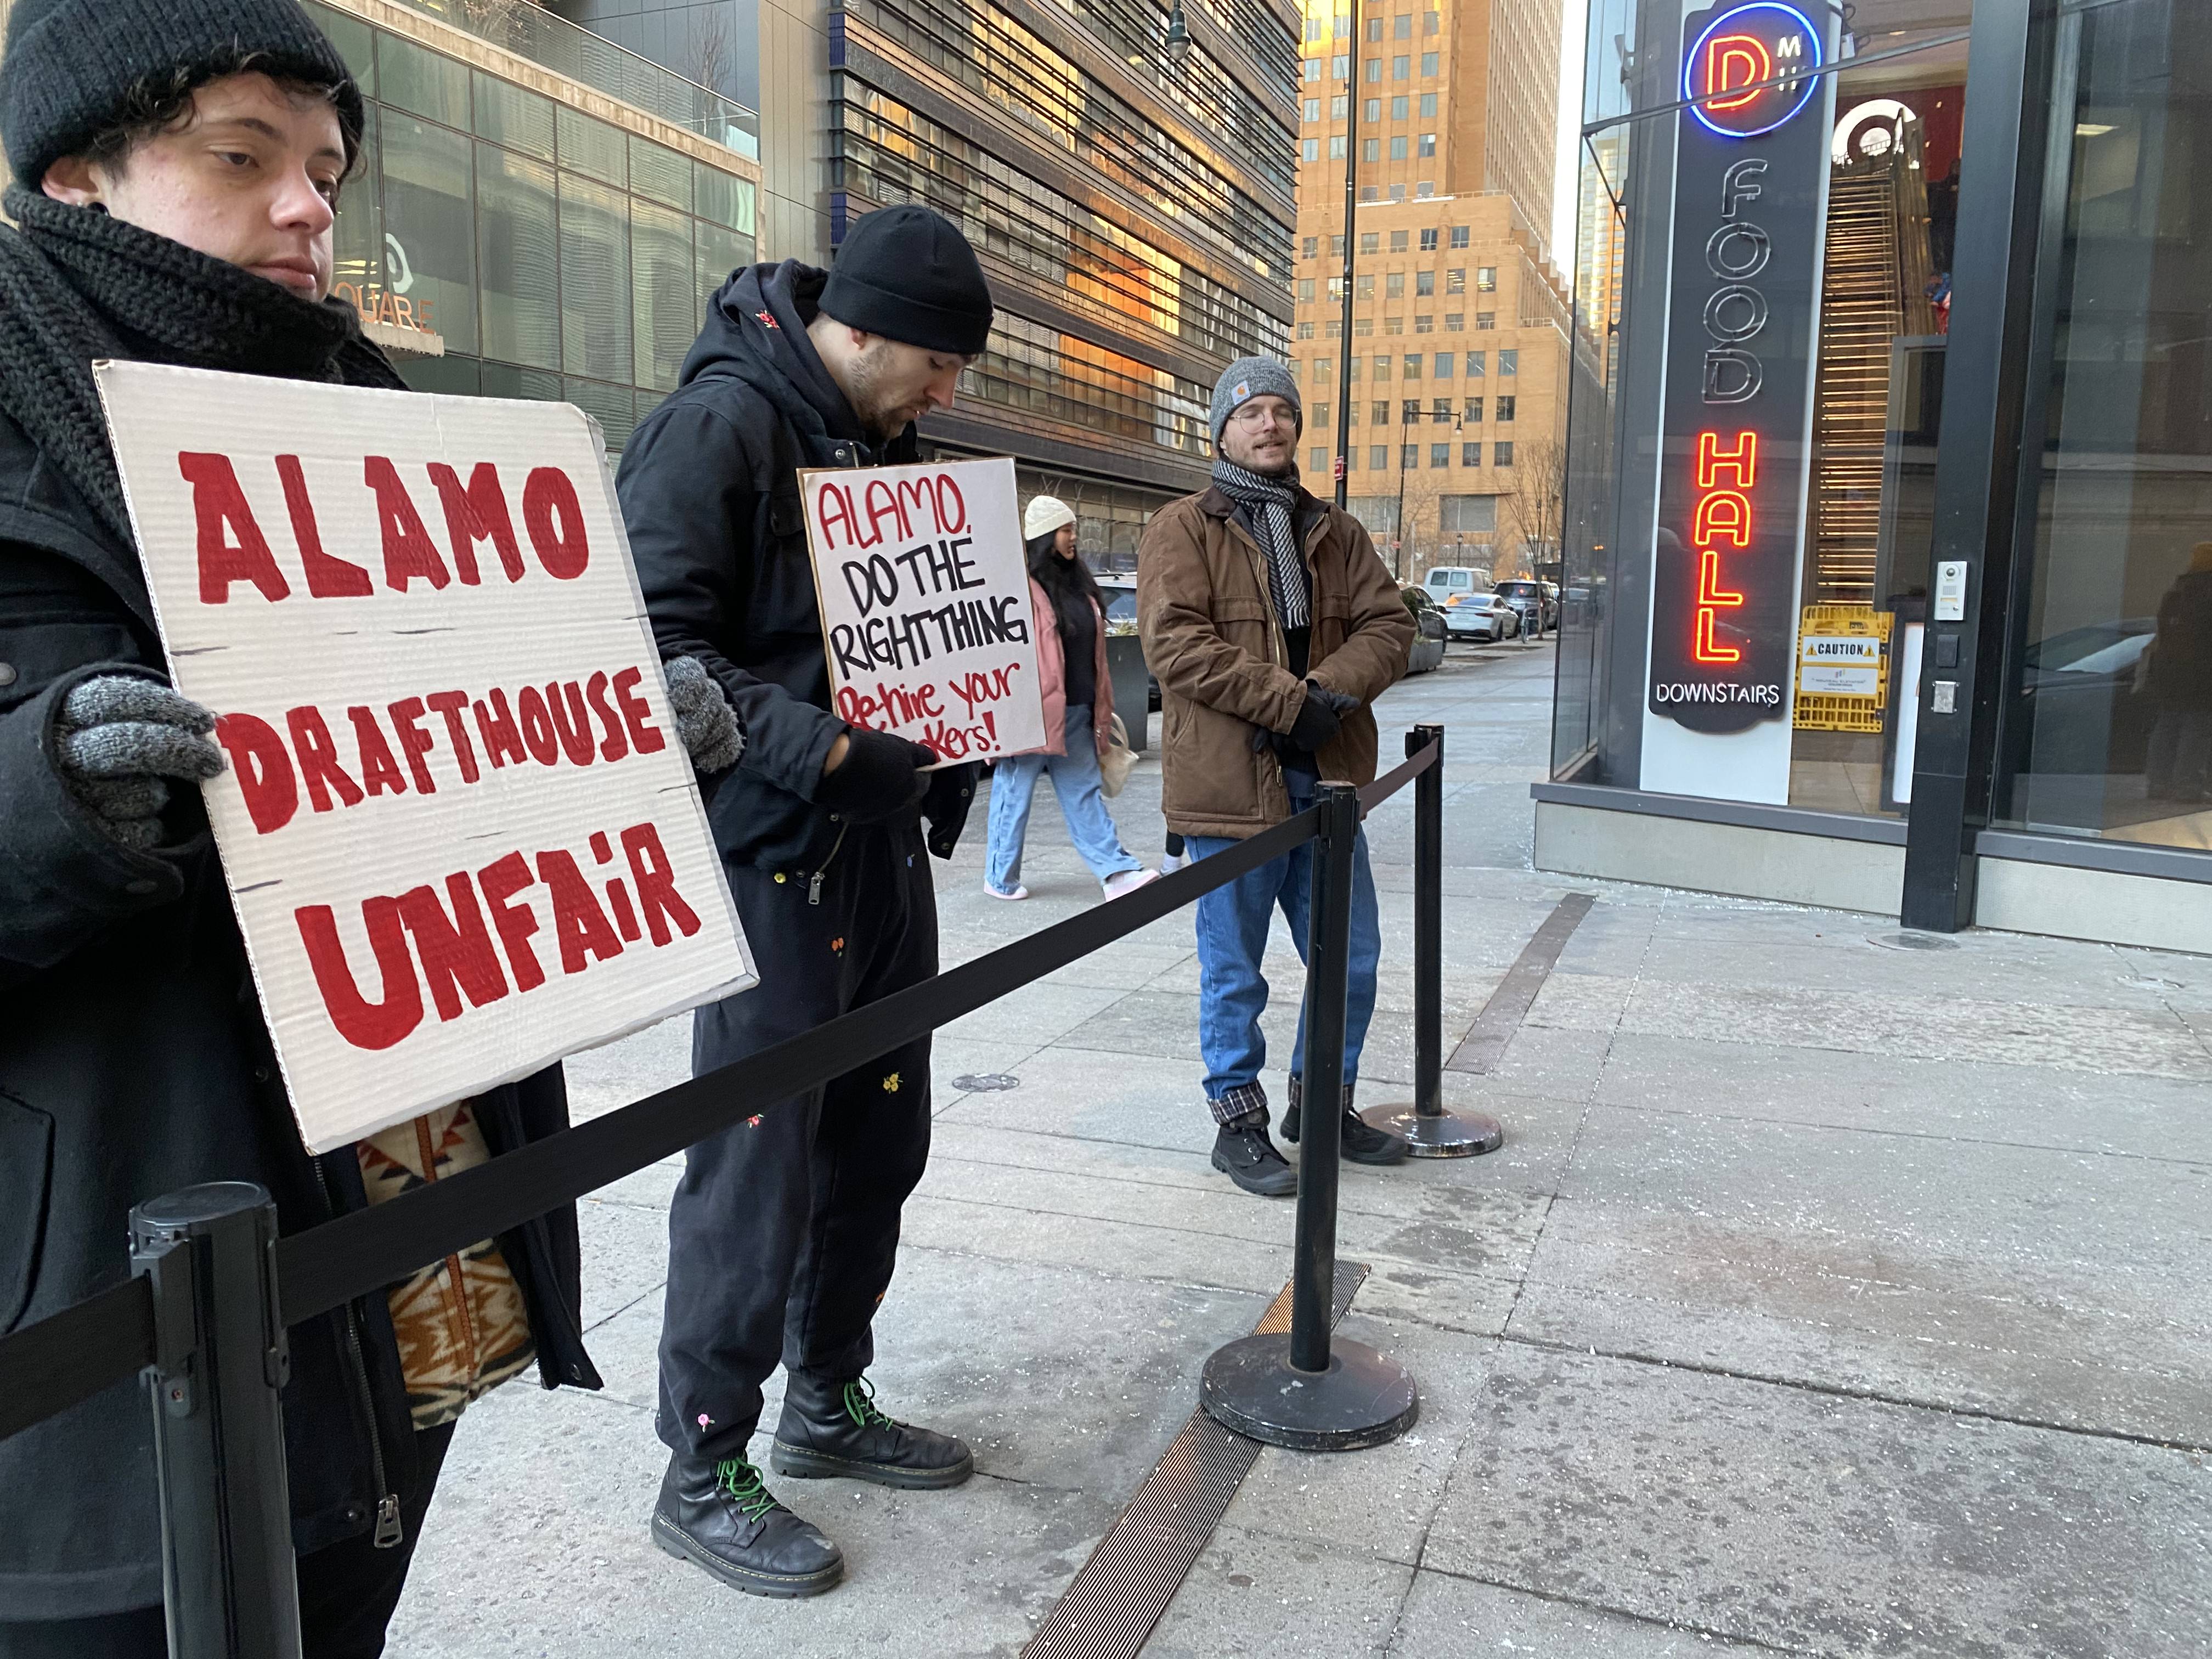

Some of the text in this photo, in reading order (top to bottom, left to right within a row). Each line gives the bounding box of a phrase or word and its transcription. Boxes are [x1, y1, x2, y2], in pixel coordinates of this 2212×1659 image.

[1706, 35, 1770, 109] D
[1702, 158, 1771, 404] FOOD
[179, 451, 589, 603] ALAMO
[1695, 432, 1756, 662] HALL
[842, 537, 985, 618] DO THE
[1818, 644, 1863, 654] CAUTION
[948, 663, 1020, 720] your
[1656, 684, 1780, 704] DOWNSTAIRS
[217, 667, 664, 834] DRAFTHOUSE
